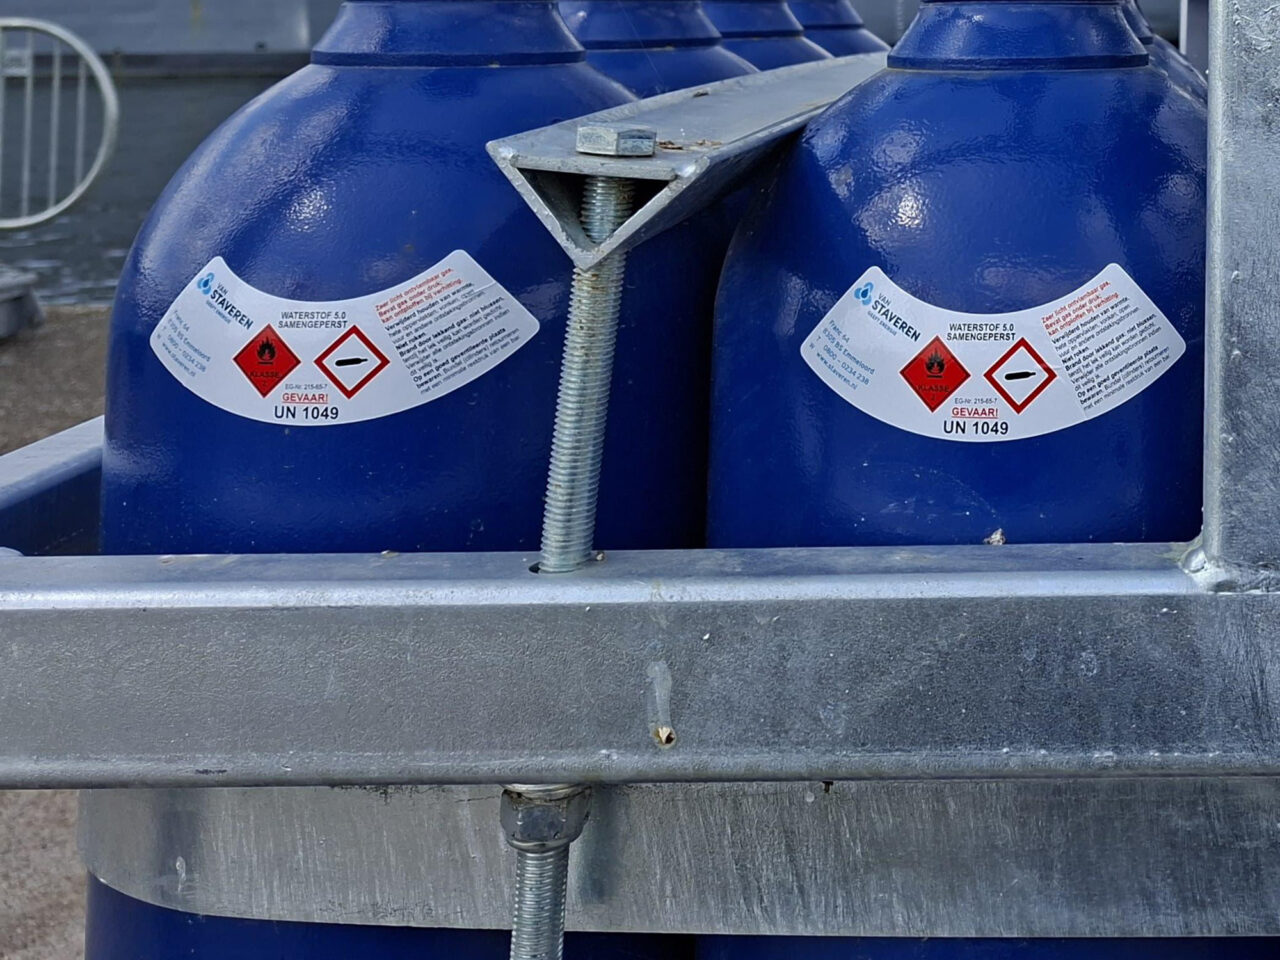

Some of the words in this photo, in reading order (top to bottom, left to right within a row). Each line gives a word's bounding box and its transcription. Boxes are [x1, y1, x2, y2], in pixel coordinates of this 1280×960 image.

[878, 293, 891, 305] VAN
[211, 290, 253, 330] STAVEREN
[872, 300, 920, 342] STAVEREN
[947, 333, 1015, 341] SAMENGEPERST
[282, 393, 328, 402] GEVAAR!
[275, 406, 296, 419] UN
[303, 407, 338, 419] 1049
[952, 408, 998, 417] GEVAAR!
[944, 420, 965, 434] UN
[973, 421, 1008, 434] 1049
